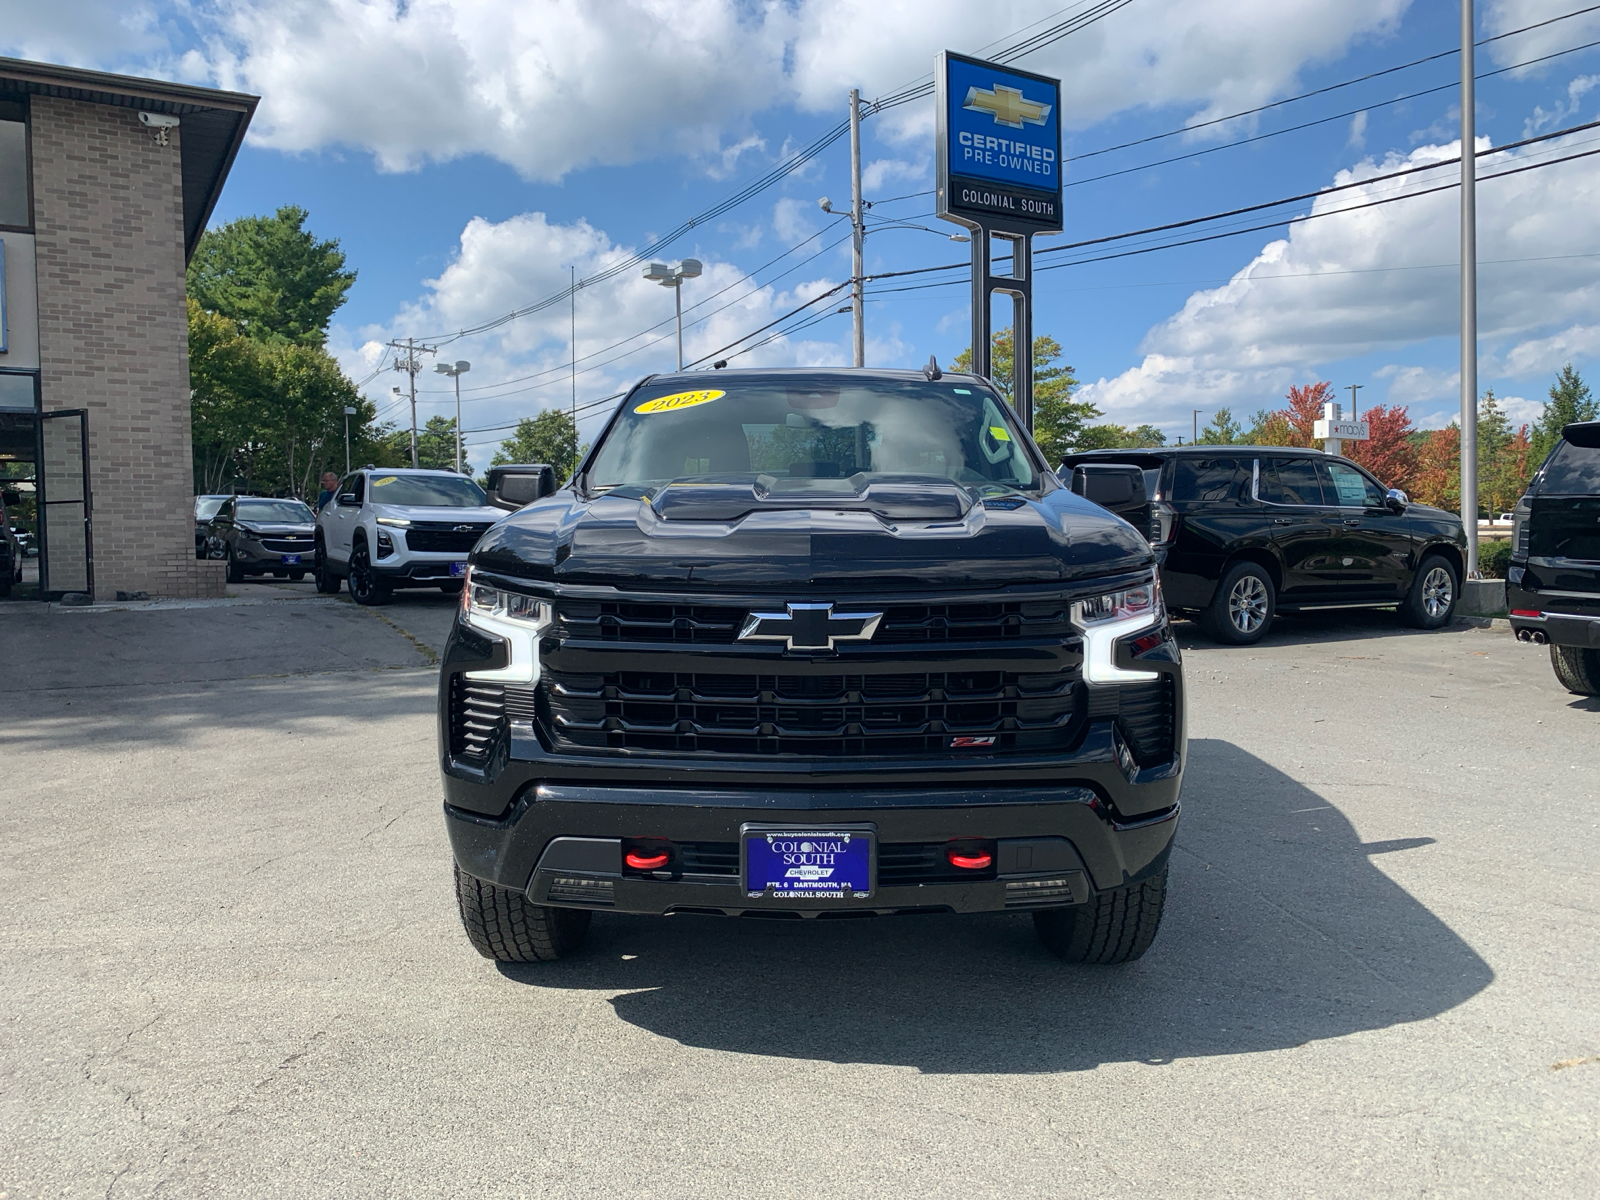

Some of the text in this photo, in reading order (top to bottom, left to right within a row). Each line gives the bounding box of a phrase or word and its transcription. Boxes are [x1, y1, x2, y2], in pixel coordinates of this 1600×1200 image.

[959, 131, 1055, 162] CERTIFIED
[964, 148, 1051, 175] PRE-OWNED
[962, 188, 1054, 215] COLONIAL SOUTH
[650, 391, 711, 412] 2023
[1339, 424, 1365, 438] macy's
[950, 736, 996, 747] Z71
[771, 841, 846, 853] COLONIAL
[783, 853, 835, 865] SOUTH
